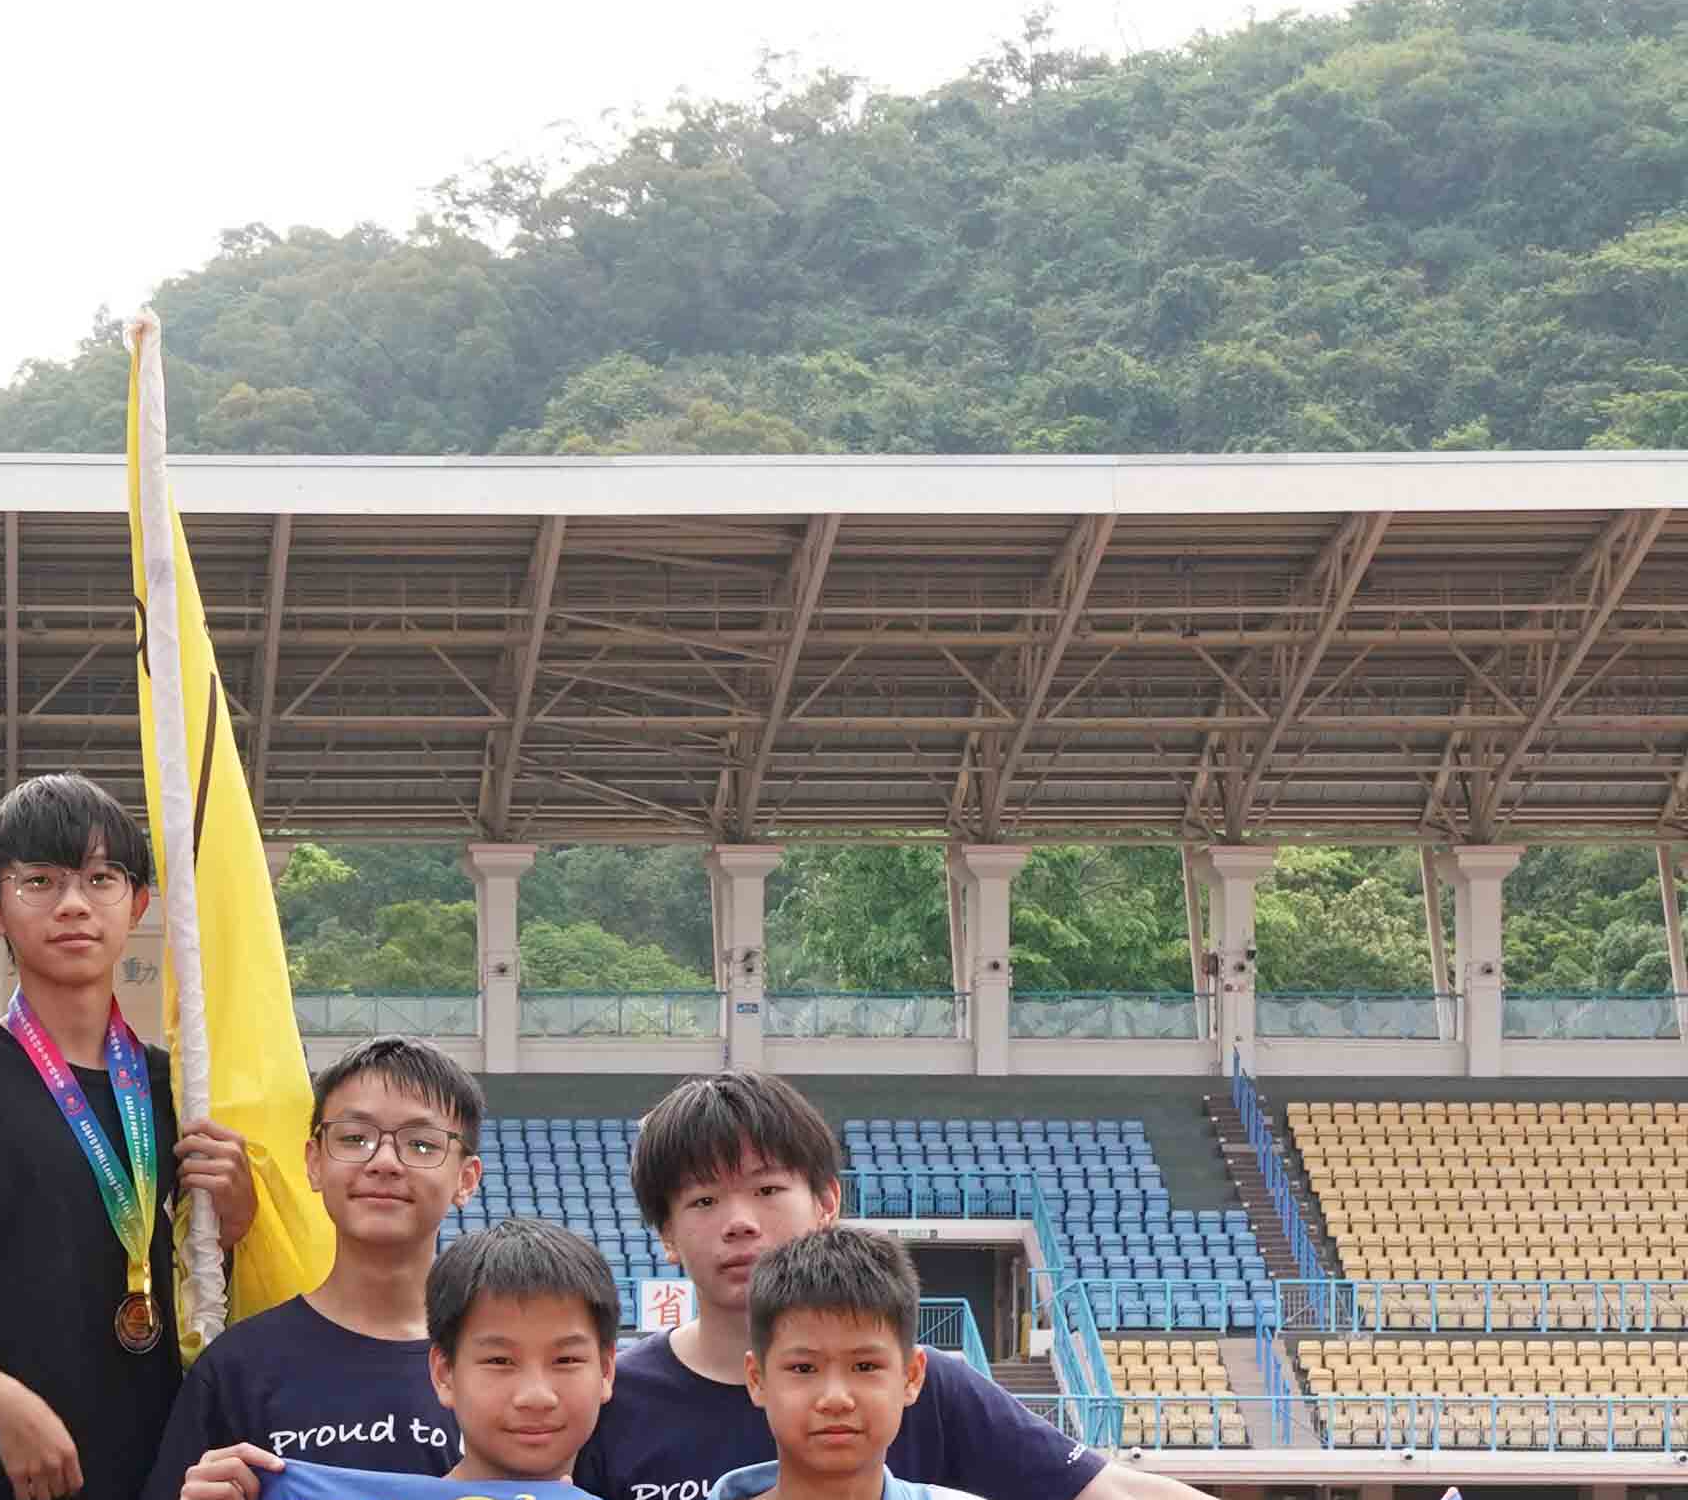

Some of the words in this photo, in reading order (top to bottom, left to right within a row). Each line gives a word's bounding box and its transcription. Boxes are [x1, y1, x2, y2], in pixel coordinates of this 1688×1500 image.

[647, 1283, 688, 1327] 省
[269, 1414, 397, 1456] Proud
[409, 1419, 448, 1448] to
